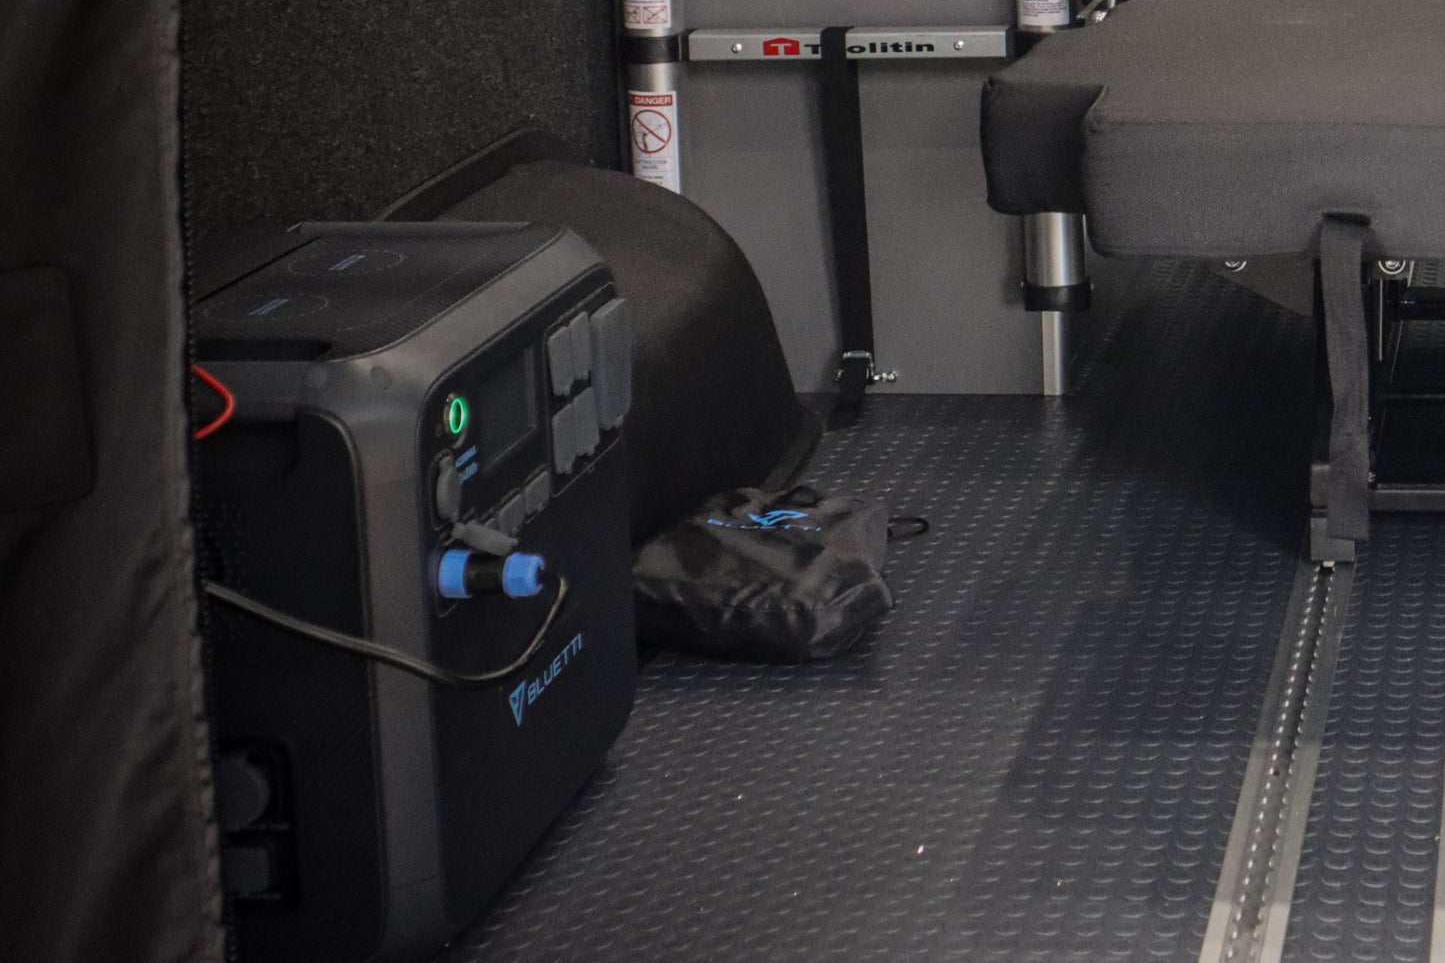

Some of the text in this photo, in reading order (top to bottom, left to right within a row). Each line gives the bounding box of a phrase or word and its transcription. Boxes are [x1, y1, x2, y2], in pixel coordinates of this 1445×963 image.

[804, 40, 935, 54] Tolitin
[634, 96, 671, 105] DANGER
[526, 632, 583, 705] BLUETTI
